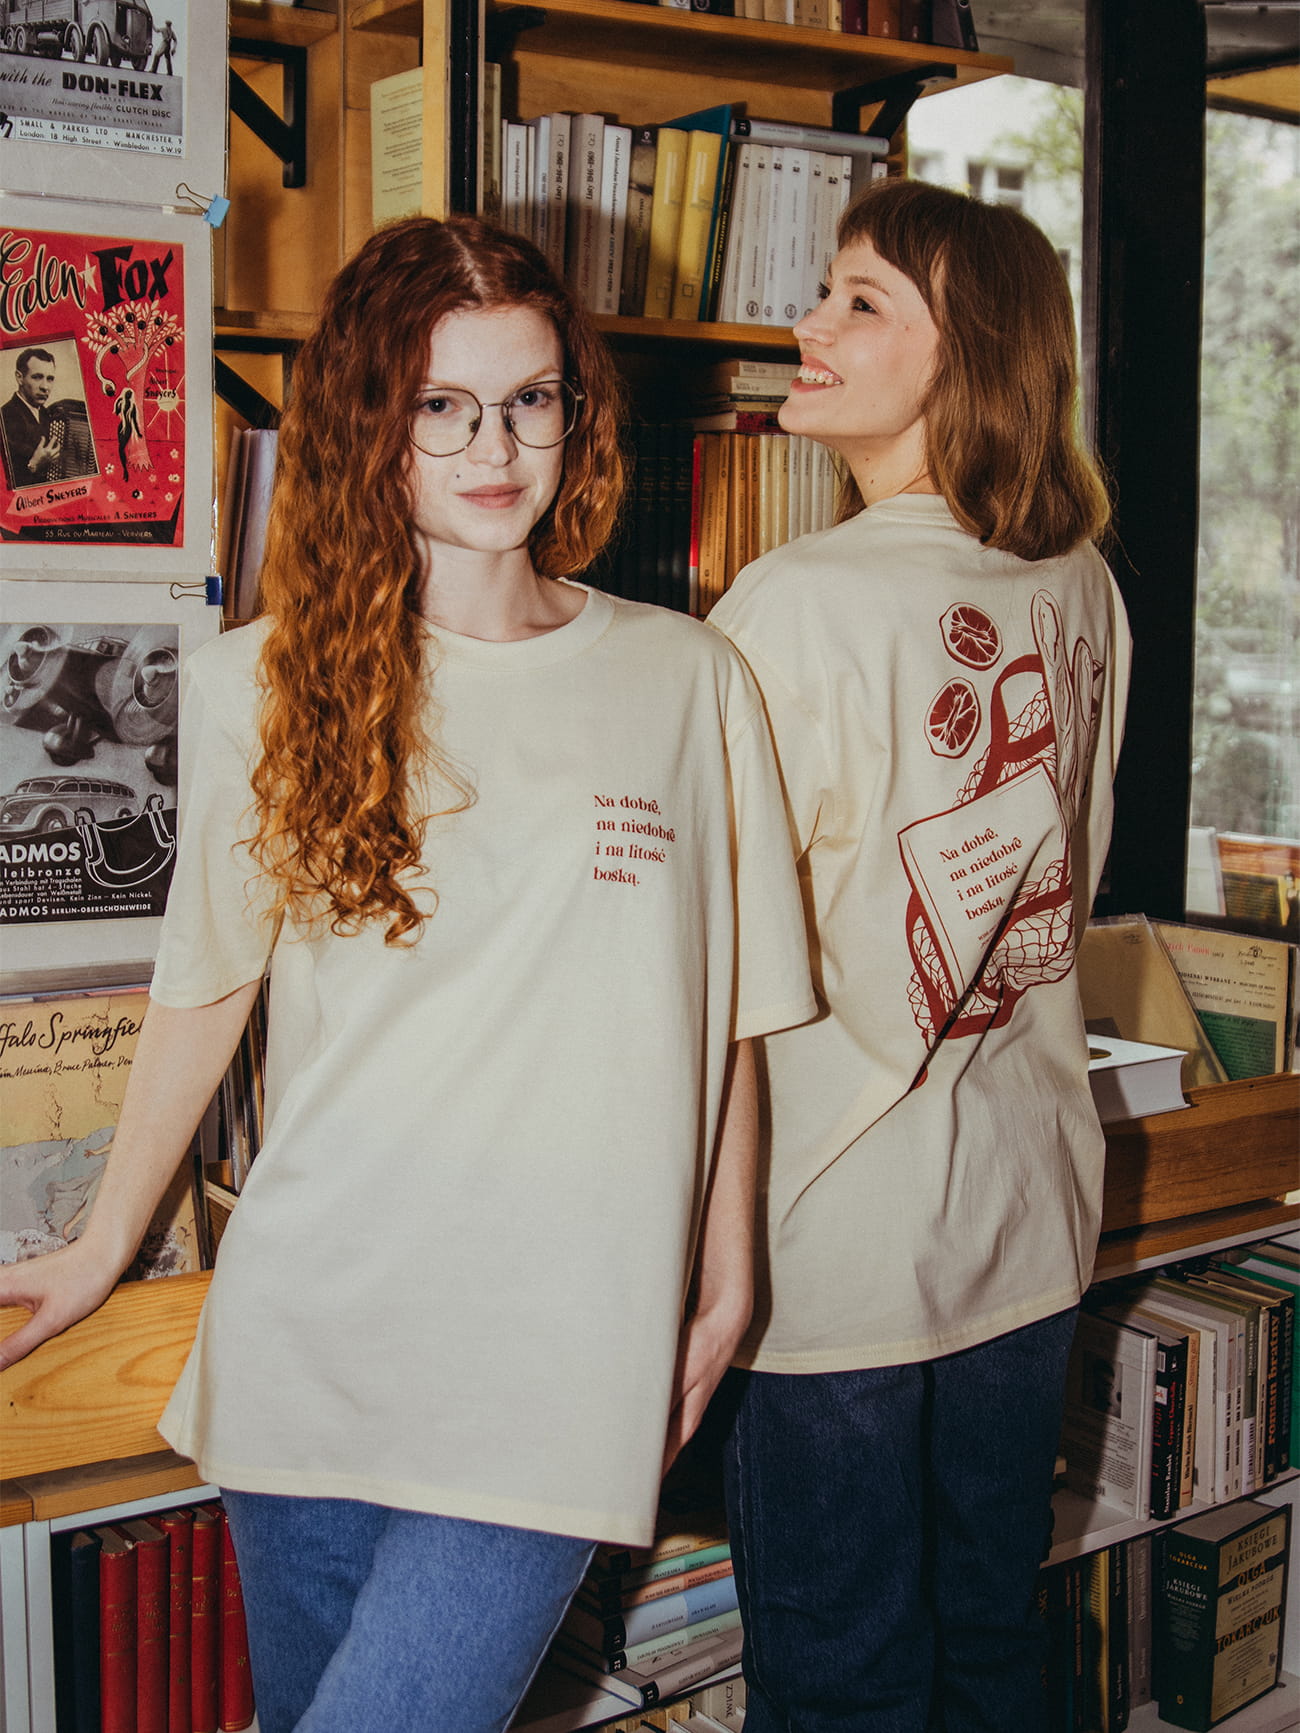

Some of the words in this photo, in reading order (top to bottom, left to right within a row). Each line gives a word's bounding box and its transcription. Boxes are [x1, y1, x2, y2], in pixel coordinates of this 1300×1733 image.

[0, 68, 28, 84] with
[32, 70, 52, 86] the
[62, 72, 163, 101] DON-FLEX
[116, 104, 149, 115] CLUTCH
[152, 110, 171, 118] DISC
[20, 119, 43, 128] SMALL
[62, 124, 89, 133] PARKES
[95, 128, 108, 136] LTD
[20, 130, 44, 139] London
[62, 134, 78, 142] High
[82, 136, 101, 145] Street
[113, 140, 150, 151] Wimbledon
[586, 184, 594, 200] Listy
[0, 231, 87, 332] Eden
[90, 245, 174, 313] Fox
[15, 495, 44, 512] Albert
[593, 794, 615, 808] Na
[619, 795, 661, 816] dobre,
[596, 819, 616, 831] na
[621, 819, 676, 842] niedobre
[0, 842, 81, 864] ADMOS
[596, 841, 600, 856] i
[605, 845, 624, 857] na
[628, 844, 666, 863] litość
[939, 848, 960, 863] Na
[949, 868, 968, 882] na
[969, 837, 1023, 873] niedobre
[0, 867, 81, 878] leibronze
[5, 879, 39, 887] Verbindung
[593, 866, 640, 887] boską.
[956, 889, 964, 901] i
[966, 884, 984, 898] na
[985, 862, 1018, 889] litość
[0, 905, 49, 917] ADMOS
[965, 896, 1005, 920] boską.
[1268, 1315, 1280, 1380] bratny
[1282, 1306, 1293, 1373] bratny
[1268, 1382, 1278, 1445] roman
[1281, 1374, 1290, 1435] roman
[1238, 1526, 1270, 1552] KSIĘGI
[1226, 1534, 1278, 1575] JAKUBOWE
[1166, 1580, 1208, 1601] JAKUBOWE
